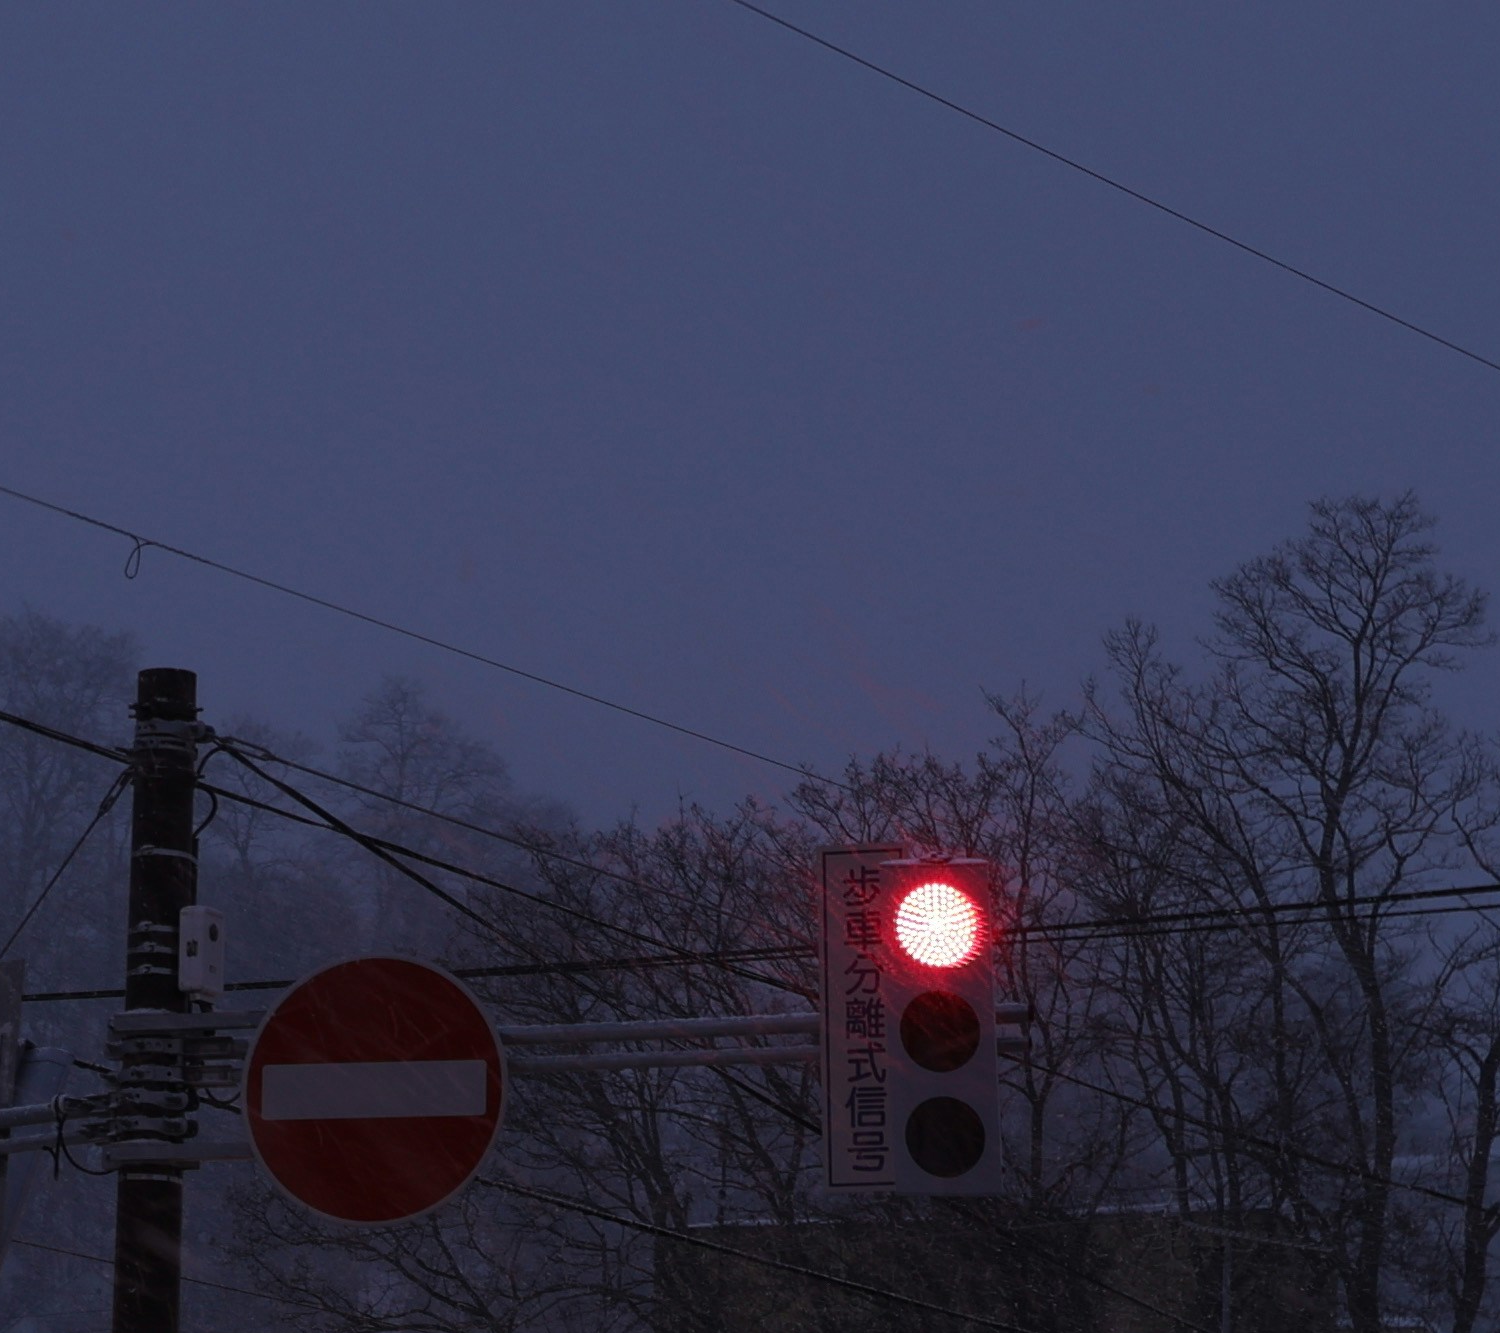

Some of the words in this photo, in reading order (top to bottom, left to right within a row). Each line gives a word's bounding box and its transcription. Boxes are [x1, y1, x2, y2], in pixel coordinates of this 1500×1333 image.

[842, 865, 890, 1174] 歩車分離式信号
